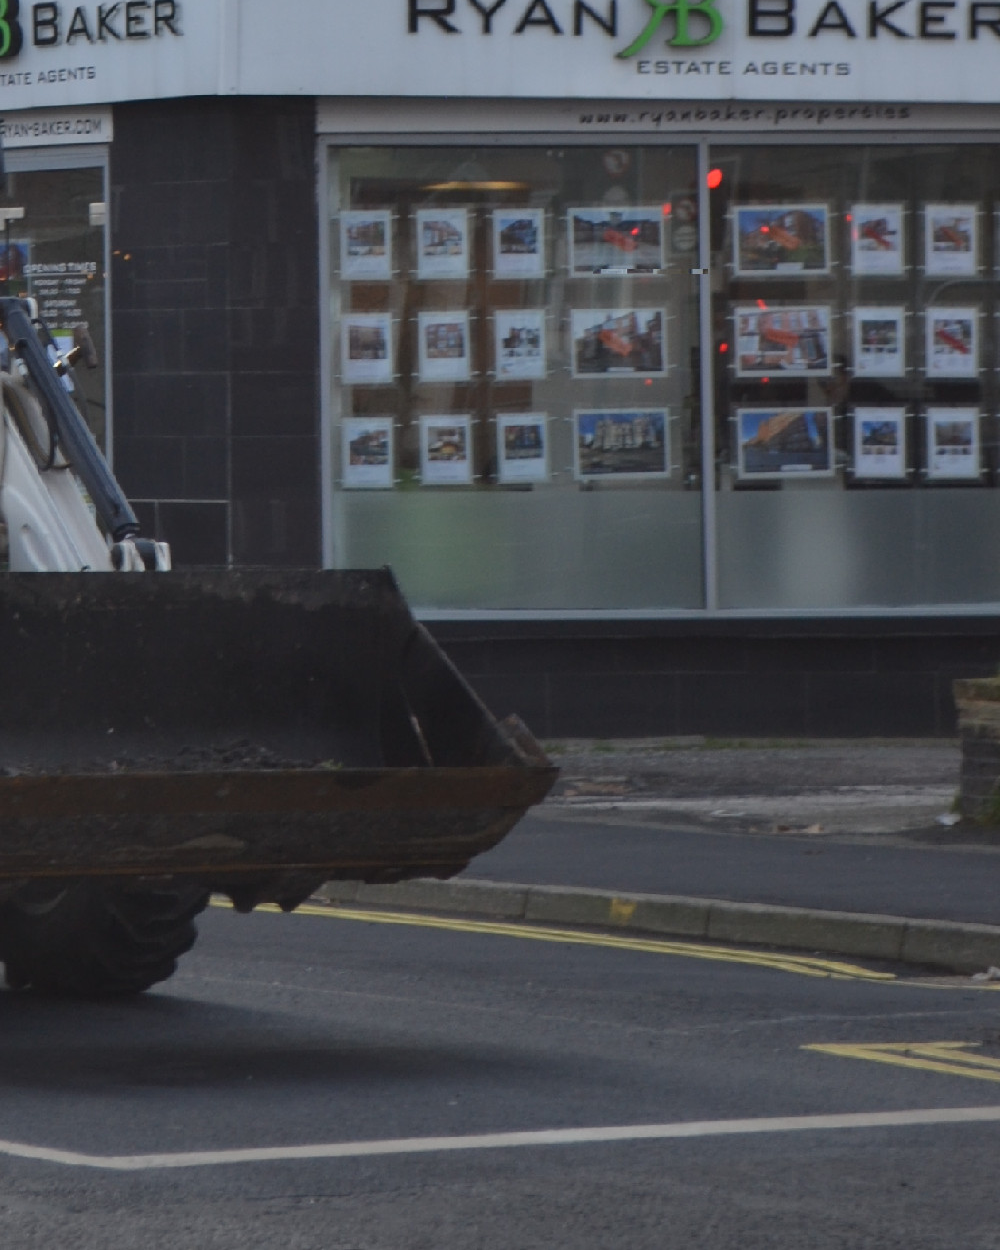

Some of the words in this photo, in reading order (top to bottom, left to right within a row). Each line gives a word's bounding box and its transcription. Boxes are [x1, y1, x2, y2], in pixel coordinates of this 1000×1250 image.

[37, 65, 97, 84] AGENTS
[636, 59, 731, 76] ESTATE
[742, 60, 851, 77] AGENTS
